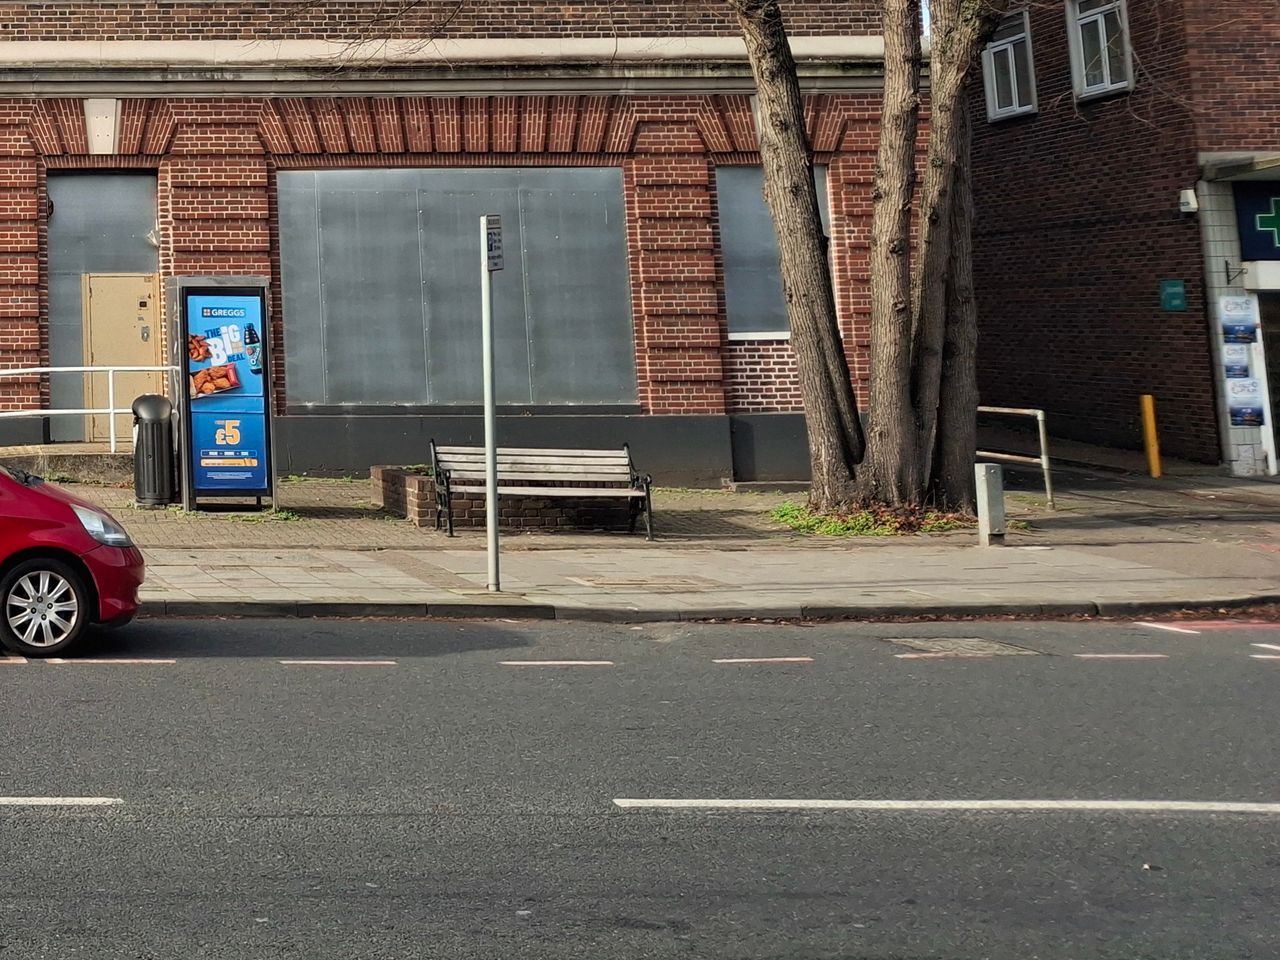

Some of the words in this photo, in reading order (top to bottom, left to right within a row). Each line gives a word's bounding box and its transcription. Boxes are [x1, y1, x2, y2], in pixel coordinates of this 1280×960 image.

[211, 308, 245, 317] GREGGS
[204, 327, 222, 339] THE
[227, 353, 245, 362] DEAL
[215, 419, 241, 445] £5
